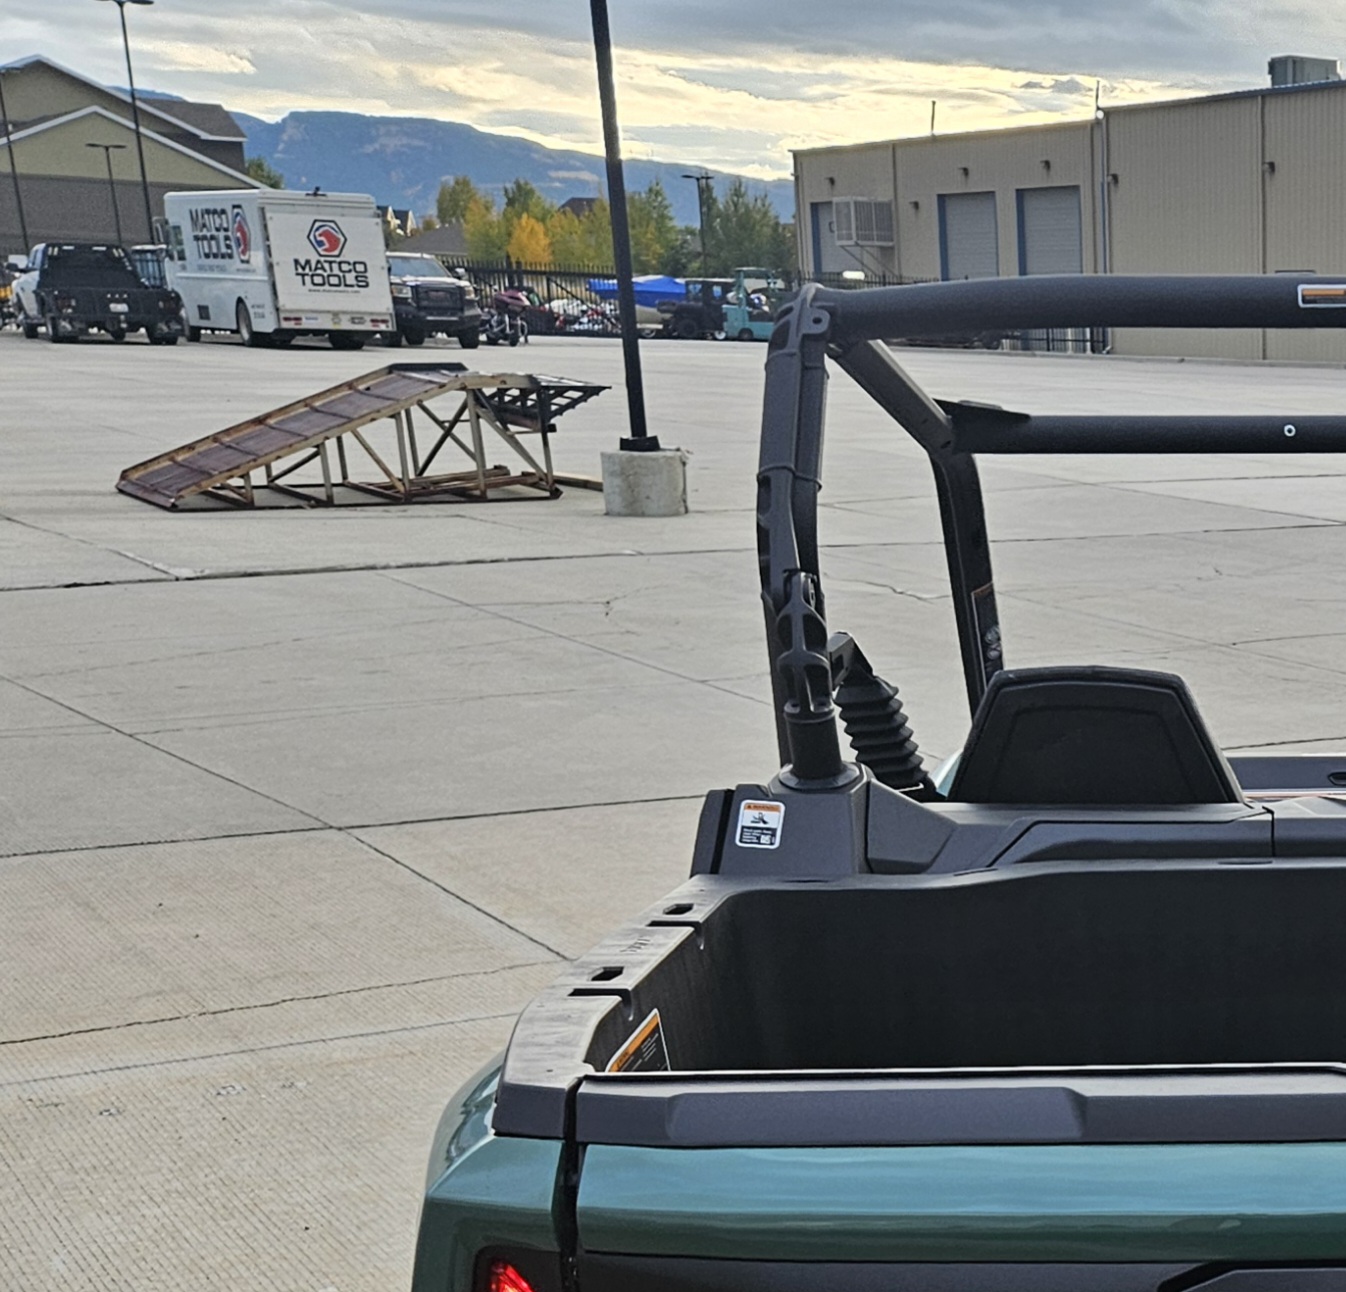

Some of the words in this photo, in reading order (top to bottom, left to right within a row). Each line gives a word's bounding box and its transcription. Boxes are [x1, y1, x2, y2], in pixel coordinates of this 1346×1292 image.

[189, 208, 230, 233] MATCO
[193, 234, 234, 260] TOOLS
[293, 258, 368, 274] MATCO
[295, 272, 370, 289] TOOLS
